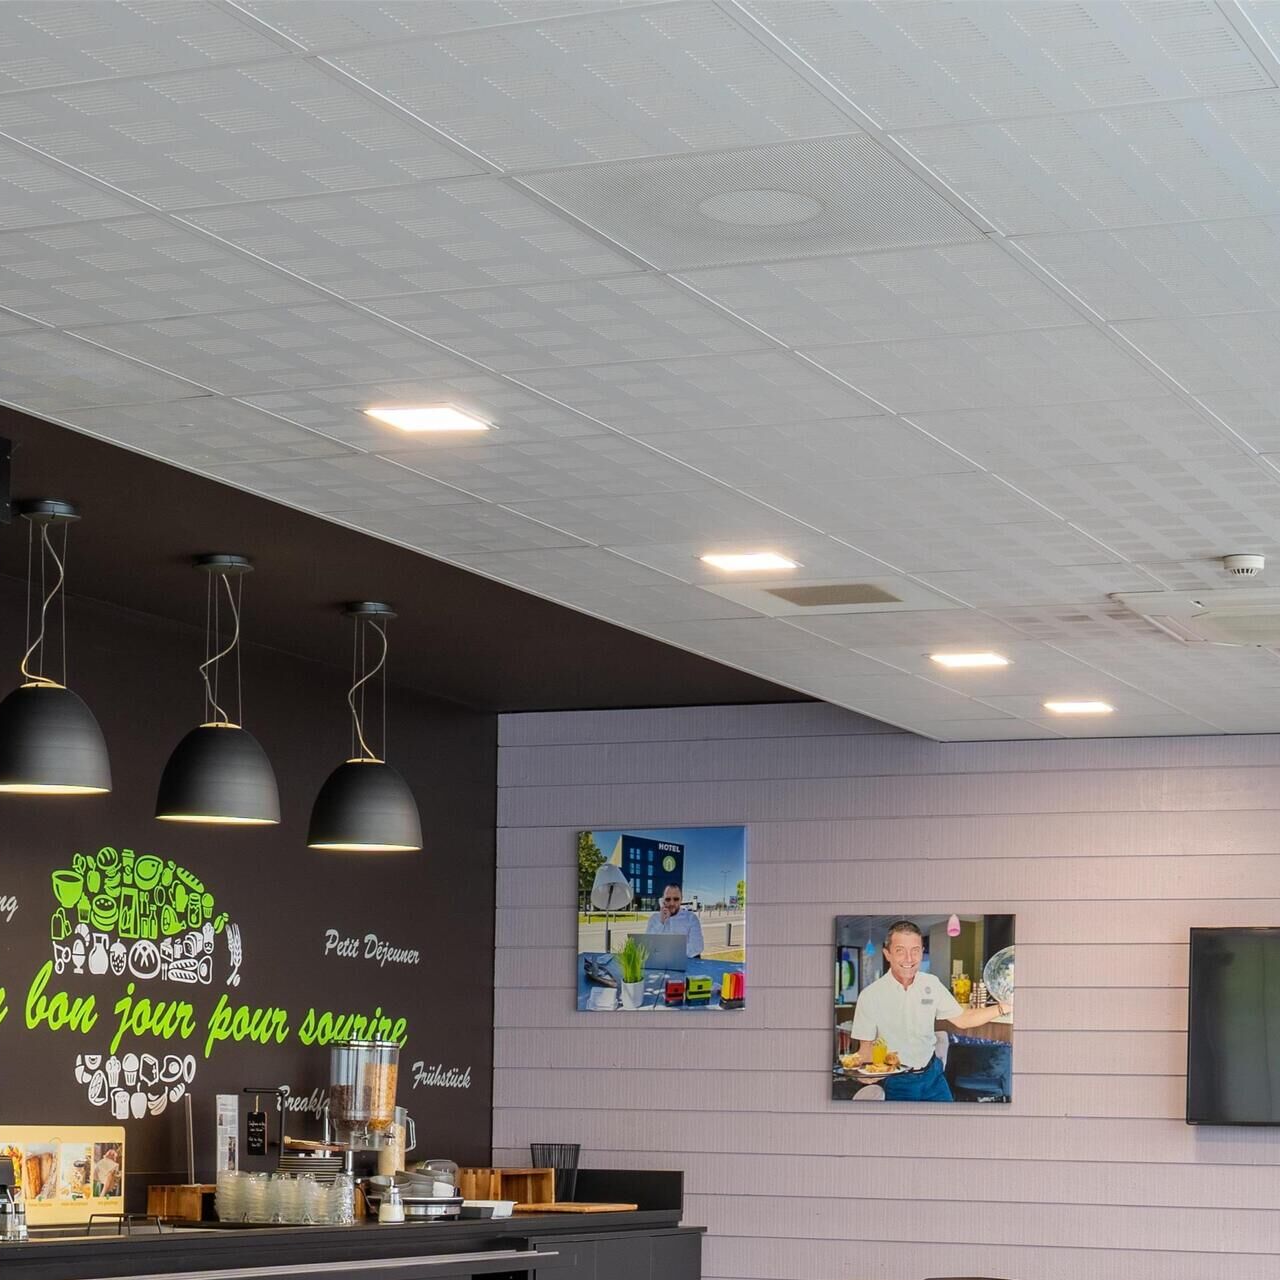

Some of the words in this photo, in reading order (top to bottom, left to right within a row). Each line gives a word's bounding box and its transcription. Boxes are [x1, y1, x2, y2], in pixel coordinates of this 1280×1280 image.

[658, 842, 681, 853] HOTEL
[324, 928, 360, 958] Petit
[364, 933, 420, 968] Déjeuner
[25, 959, 99, 1034] bon
[109, 982, 196, 1056] jour
[204, 994, 289, 1058] pour
[298, 1006, 408, 1049] sourire
[411, 1060, 472, 1090] Frühstück
